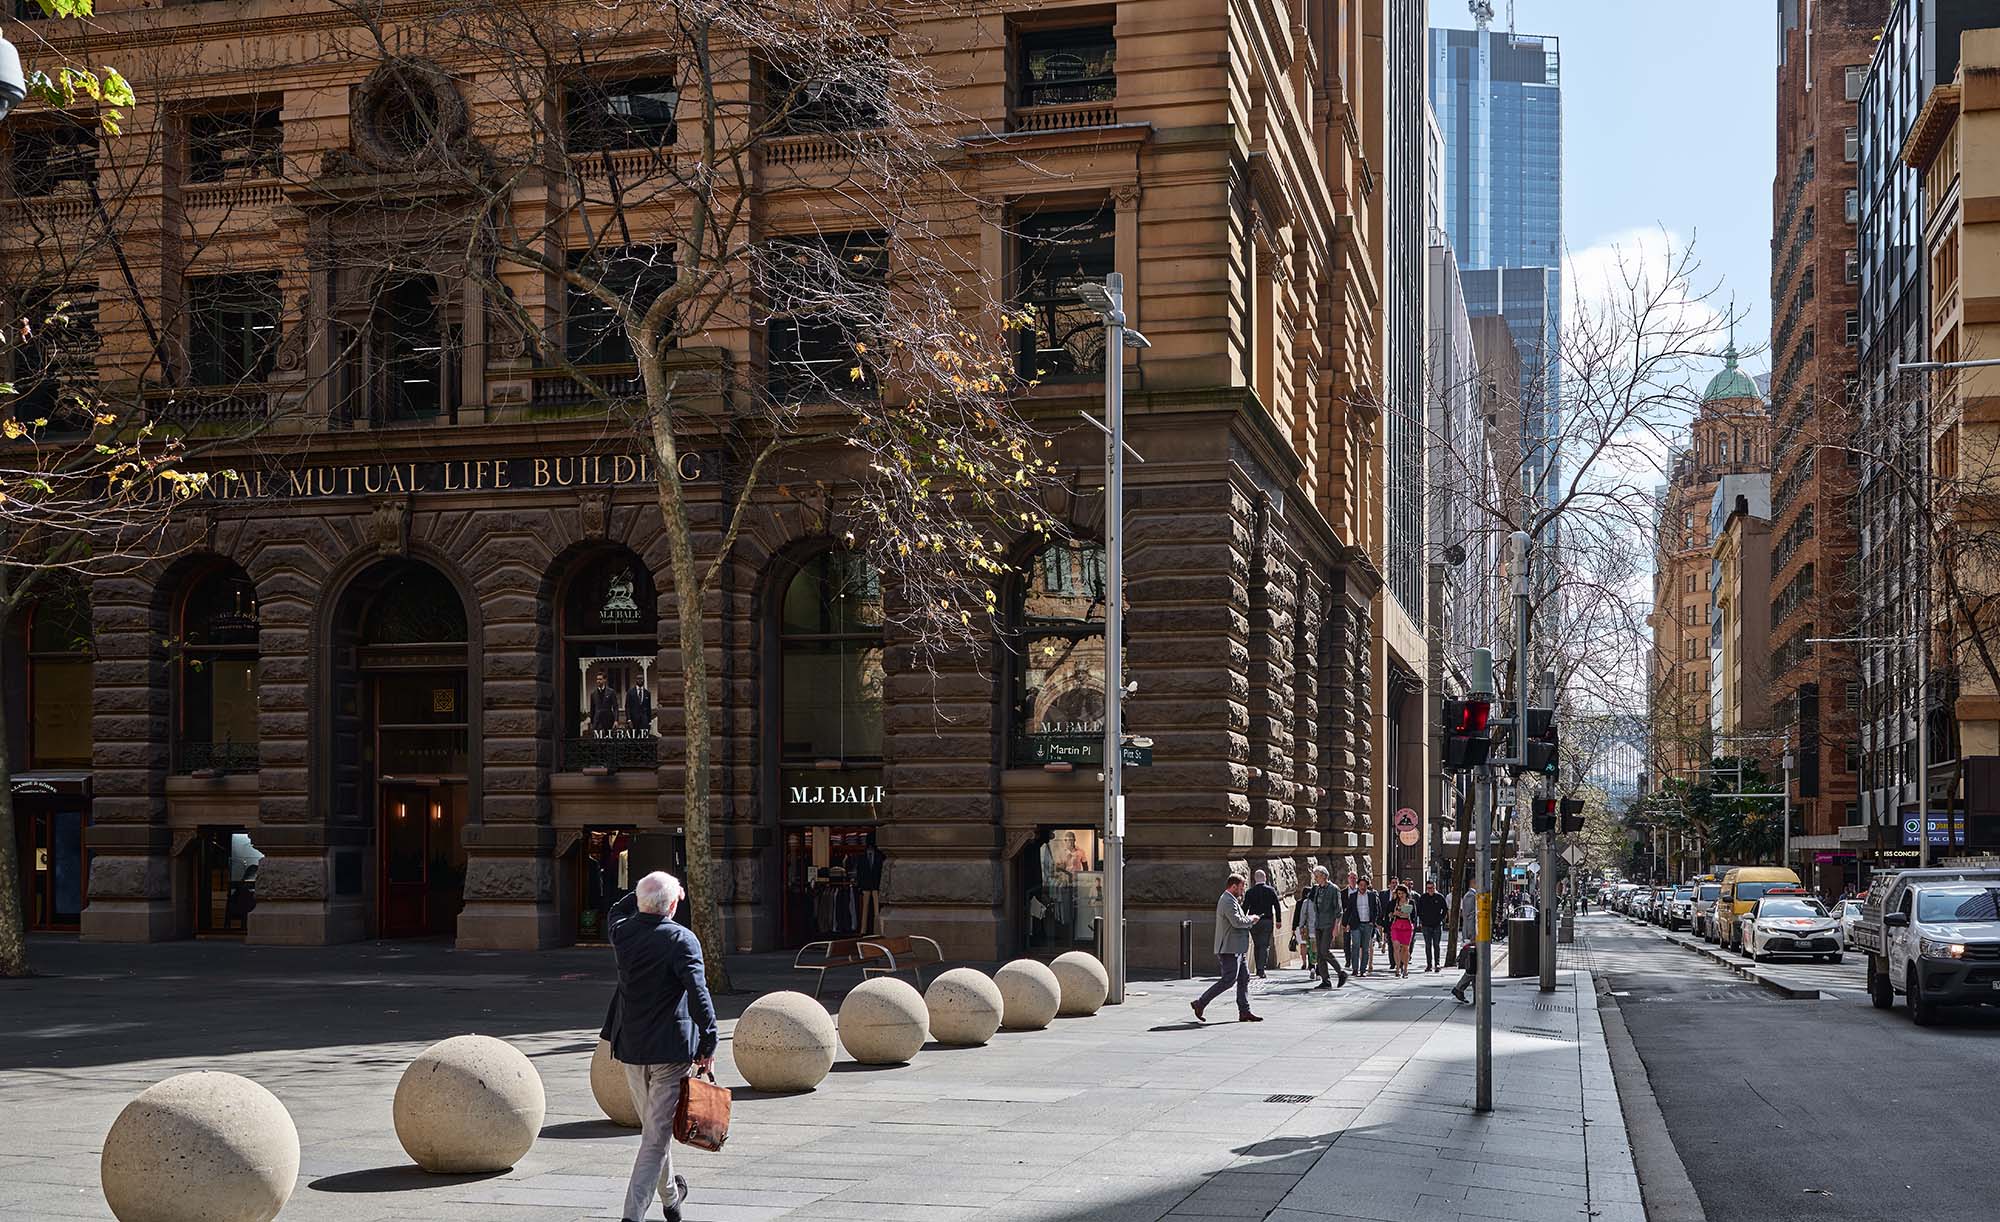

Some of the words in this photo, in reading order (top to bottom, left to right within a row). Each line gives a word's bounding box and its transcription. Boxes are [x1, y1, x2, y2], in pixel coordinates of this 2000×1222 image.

[289, 464, 424, 497] MUTUAL
[444, 459, 511, 490] LIFE
[533, 452, 701, 487] BUILDIG
[616, 610, 641, 618] BALE
[1066, 721, 1103, 732] BALE
[616, 729, 649, 739] BALE
[1050, 744, 1080, 755] Martin
[1082, 745, 1091, 756] Pl
[790, 786, 825, 803] M.J.
